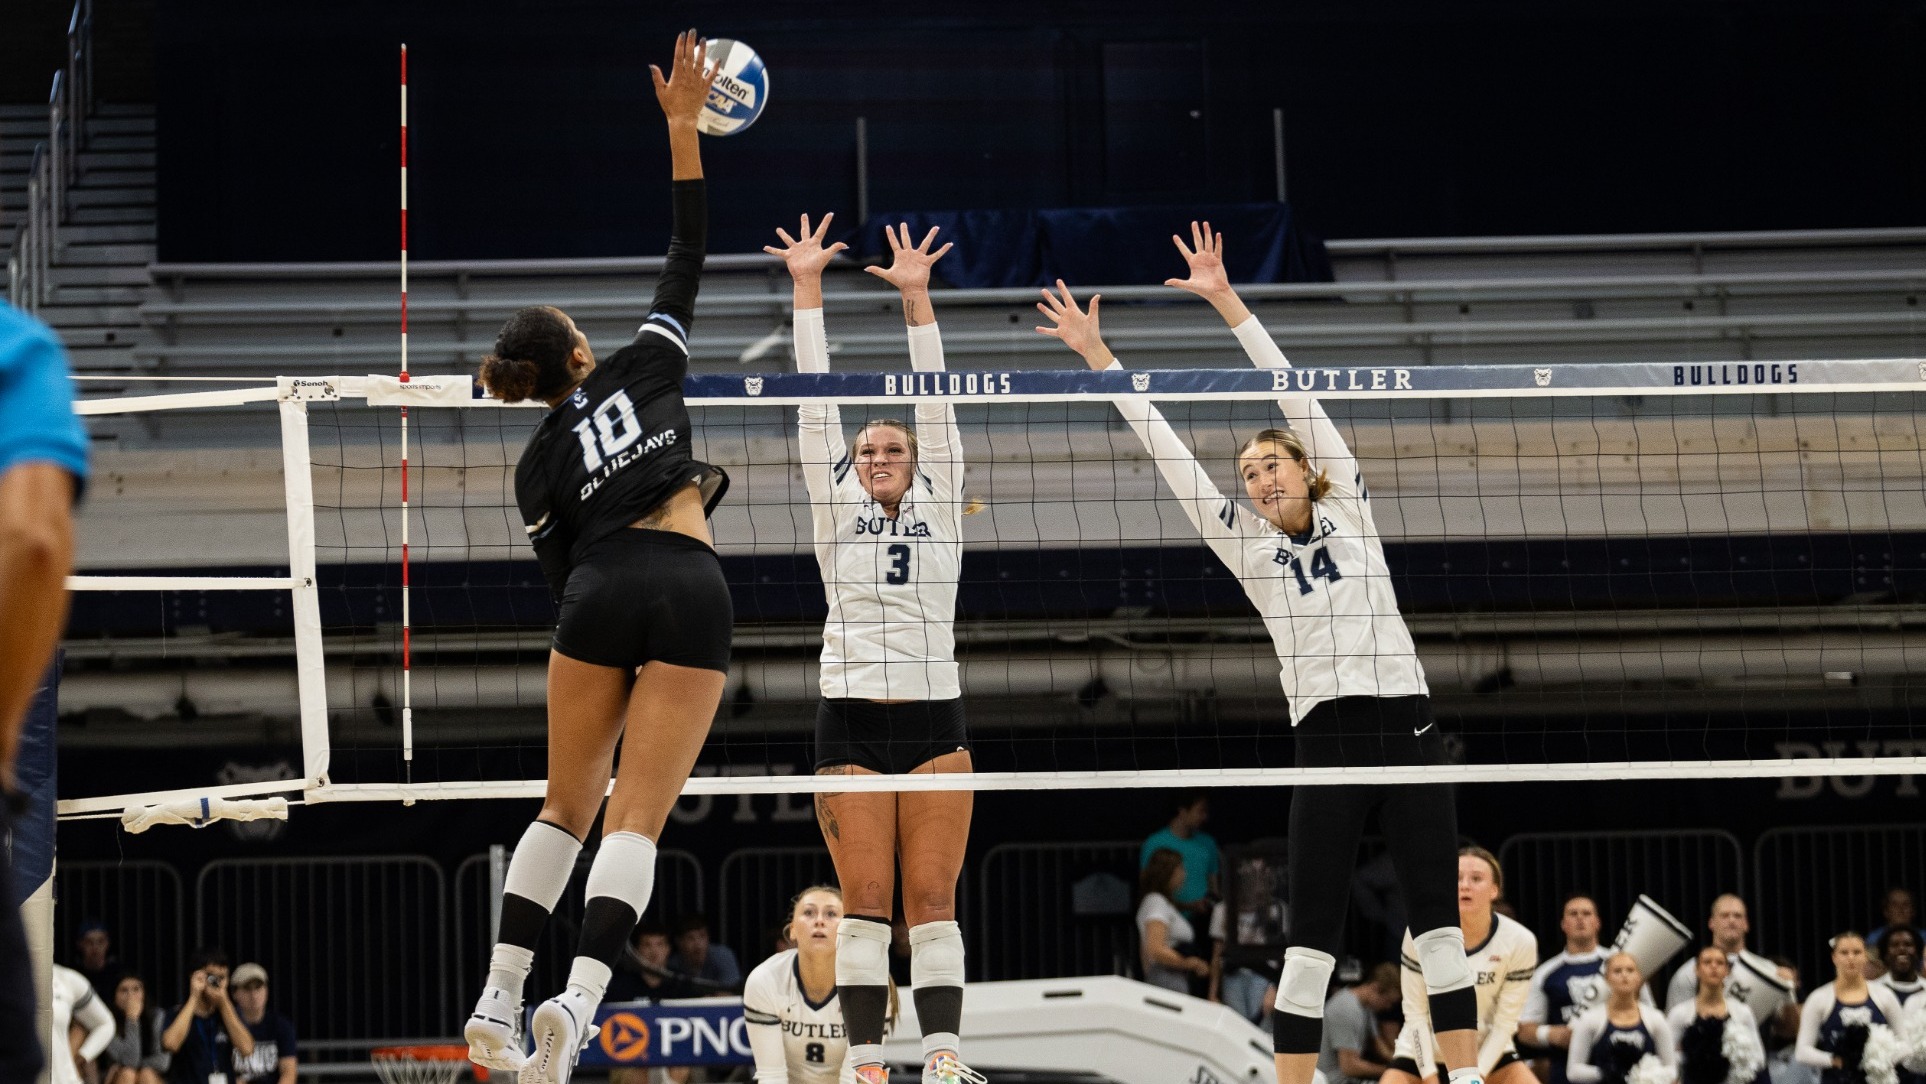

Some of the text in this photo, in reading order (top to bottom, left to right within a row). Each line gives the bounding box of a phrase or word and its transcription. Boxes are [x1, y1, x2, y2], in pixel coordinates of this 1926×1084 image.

[885, 373, 1011, 395] BULLDOGS
[1271, 369, 1413, 391] BUTLER
[1673, 364, 1798, 386] BULLDOGS
[571, 388, 643, 474] 10
[886, 544, 911, 586] 3
[1289, 545, 1343, 597] 14
[805, 1042, 825, 1063] 8
